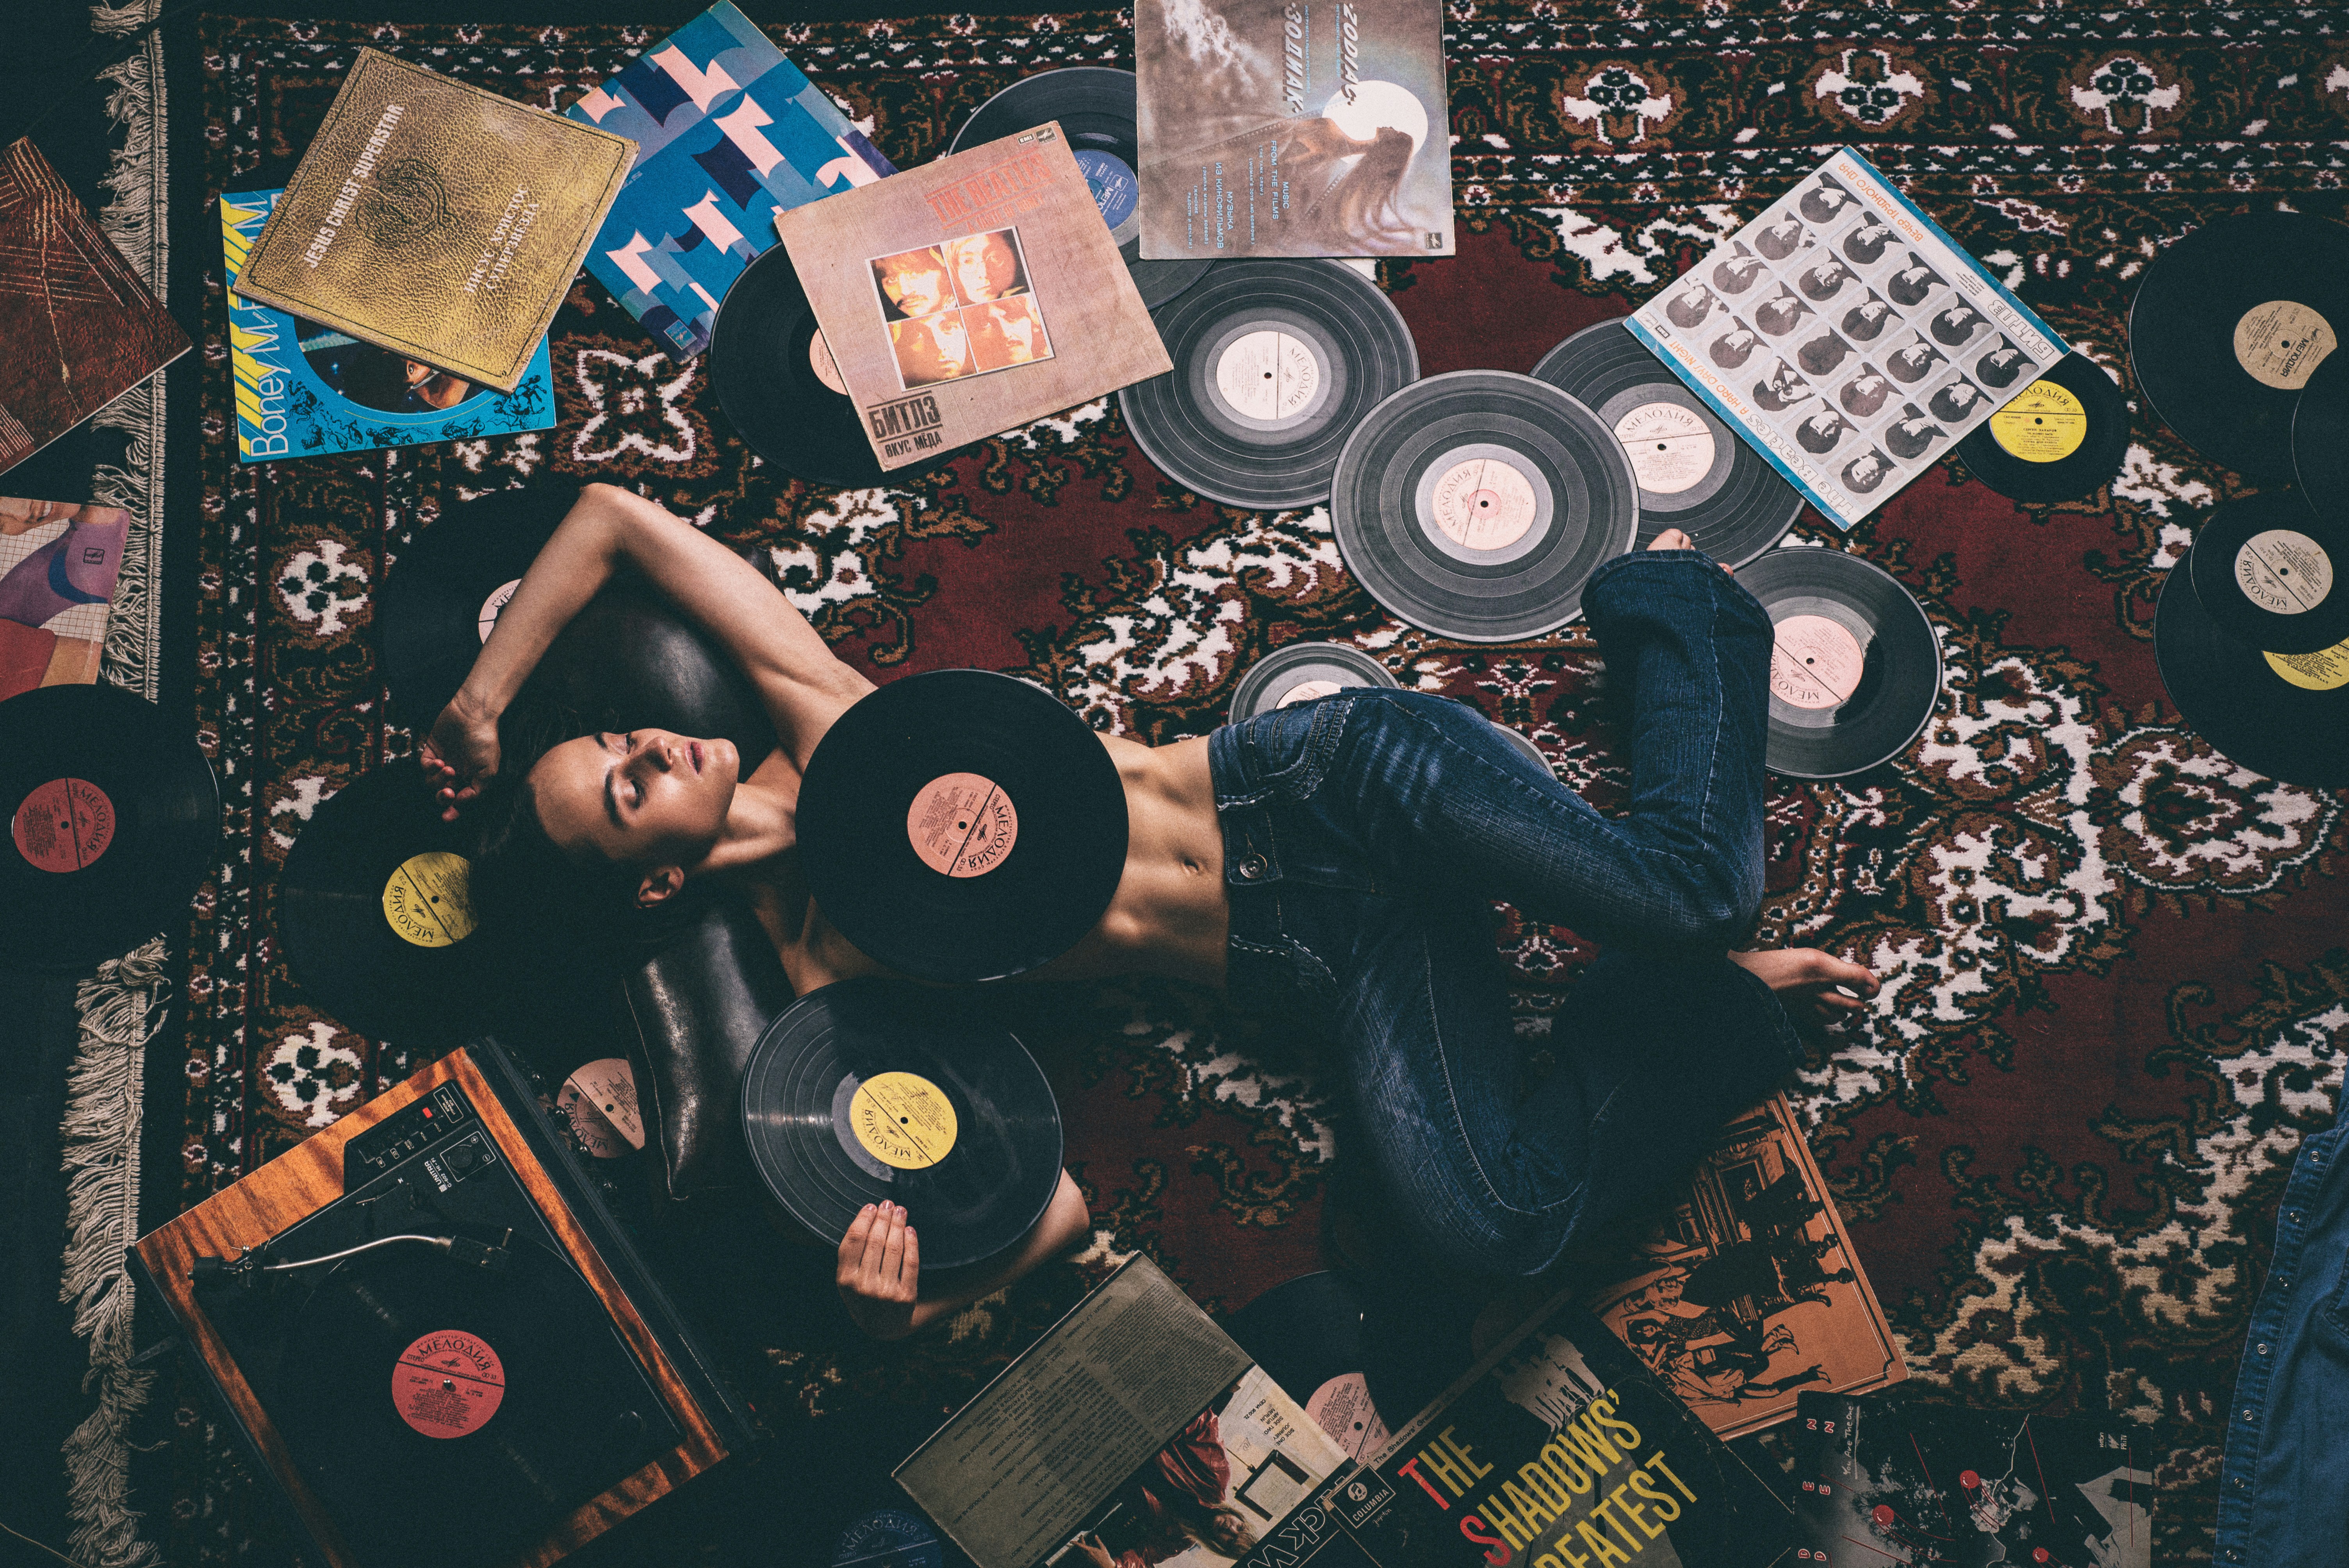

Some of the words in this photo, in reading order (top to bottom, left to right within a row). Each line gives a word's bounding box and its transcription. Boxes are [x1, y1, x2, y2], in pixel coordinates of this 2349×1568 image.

[1019, 135, 1033, 143] EMI
[301, 224, 337, 269] JESUS
[324, 177, 363, 228] CHRIST
[350, 100, 406, 180] SUPERSTAR
[1215, 162, 1221, 175] ИЗ
[1837, 161, 1858, 181] ДНЯ
[927, 187, 971, 223] THE
[965, 152, 1052, 208] BEATLES
[1854, 176, 1900, 220] ТРУДНОГО
[1214, 178, 1224, 248] КИНОФИЛЬМОВ
[1226, 191, 1234, 230] МУЗЫКА
[463, 247, 495, 292] ИИСУС
[490, 183, 529, 243] ХРИСТОС
[1895, 215, 1925, 243] ВЕЧЕР
[485, 202, 539, 290] СУПЕРЗВЕЗДА
[1656, 325, 1669, 337] EMI
[1985, 296, 2055, 362] БИТЛЗ
[1668, 339, 1697, 366] NIGHT
[2280, 337, 2309, 377] МЕЛОДИЯ
[1287, 347, 1310, 407] МЕЛОДИЯ
[250, 362, 291, 456] Boney
[1715, 382, 1742, 408] HARD
[1739, 405, 1749, 416] A
[868, 396, 940, 440] БИТЛЗ
[1626, 409, 1693, 432] МЕЛОДИЯ
[885, 440, 912, 457] ВКУС
[915, 433, 943, 451] МЁДА
[1742, 412, 1820, 484] Beatles
[1442, 469, 1471, 526] МЕЛОДИЯ
[1813, 478, 1857, 519] The
[2243, 560, 2286, 607] МЕЛОДИЯ
[989, 793, 1001, 810] СТЕРЕО
[80, 787, 105, 850] МЕЛОДИЯ
[968, 806, 1010, 868] МЕЛОДИЯ
[392, 886, 433, 939] МЕЛОДИЯ
[434, 1122, 442, 1132] СТОП
[865, 1110, 910, 1157] МЕЛОДИЯ
[424, 1160, 442, 1185] UNITRA
[407, 1354, 424, 1362] СТЕРЕО
[419, 1339, 490, 1370] МЕЛОДИЯ
[1255, 1399, 1267, 1409] CENA
[1259, 1408, 1276, 1422] MERLIN
[1265, 1411, 1280, 1424] ARTUR
[1262, 1424, 1274, 1436] TWO:
[1272, 1422, 1290, 1440] JOURNEY
[1273, 1416, 1283, 1425] SIDE
[1284, 1427, 1295, 1438] SIDE
[1274, 1436, 1286, 1447] ONE:
[1373, 1450, 1388, 1465] The
[1386, 1426, 1417, 1454] Shadows'
[1397, 1424, 1494, 1511] THE
[1460, 1388, 1641, 1566] SHADOWS'
[1842, 1462, 1851, 1475] You
[1352, 1488, 1389, 1522] COLUMBIA
[845, 1518, 916, 1550] МЕЛОДИЯ
